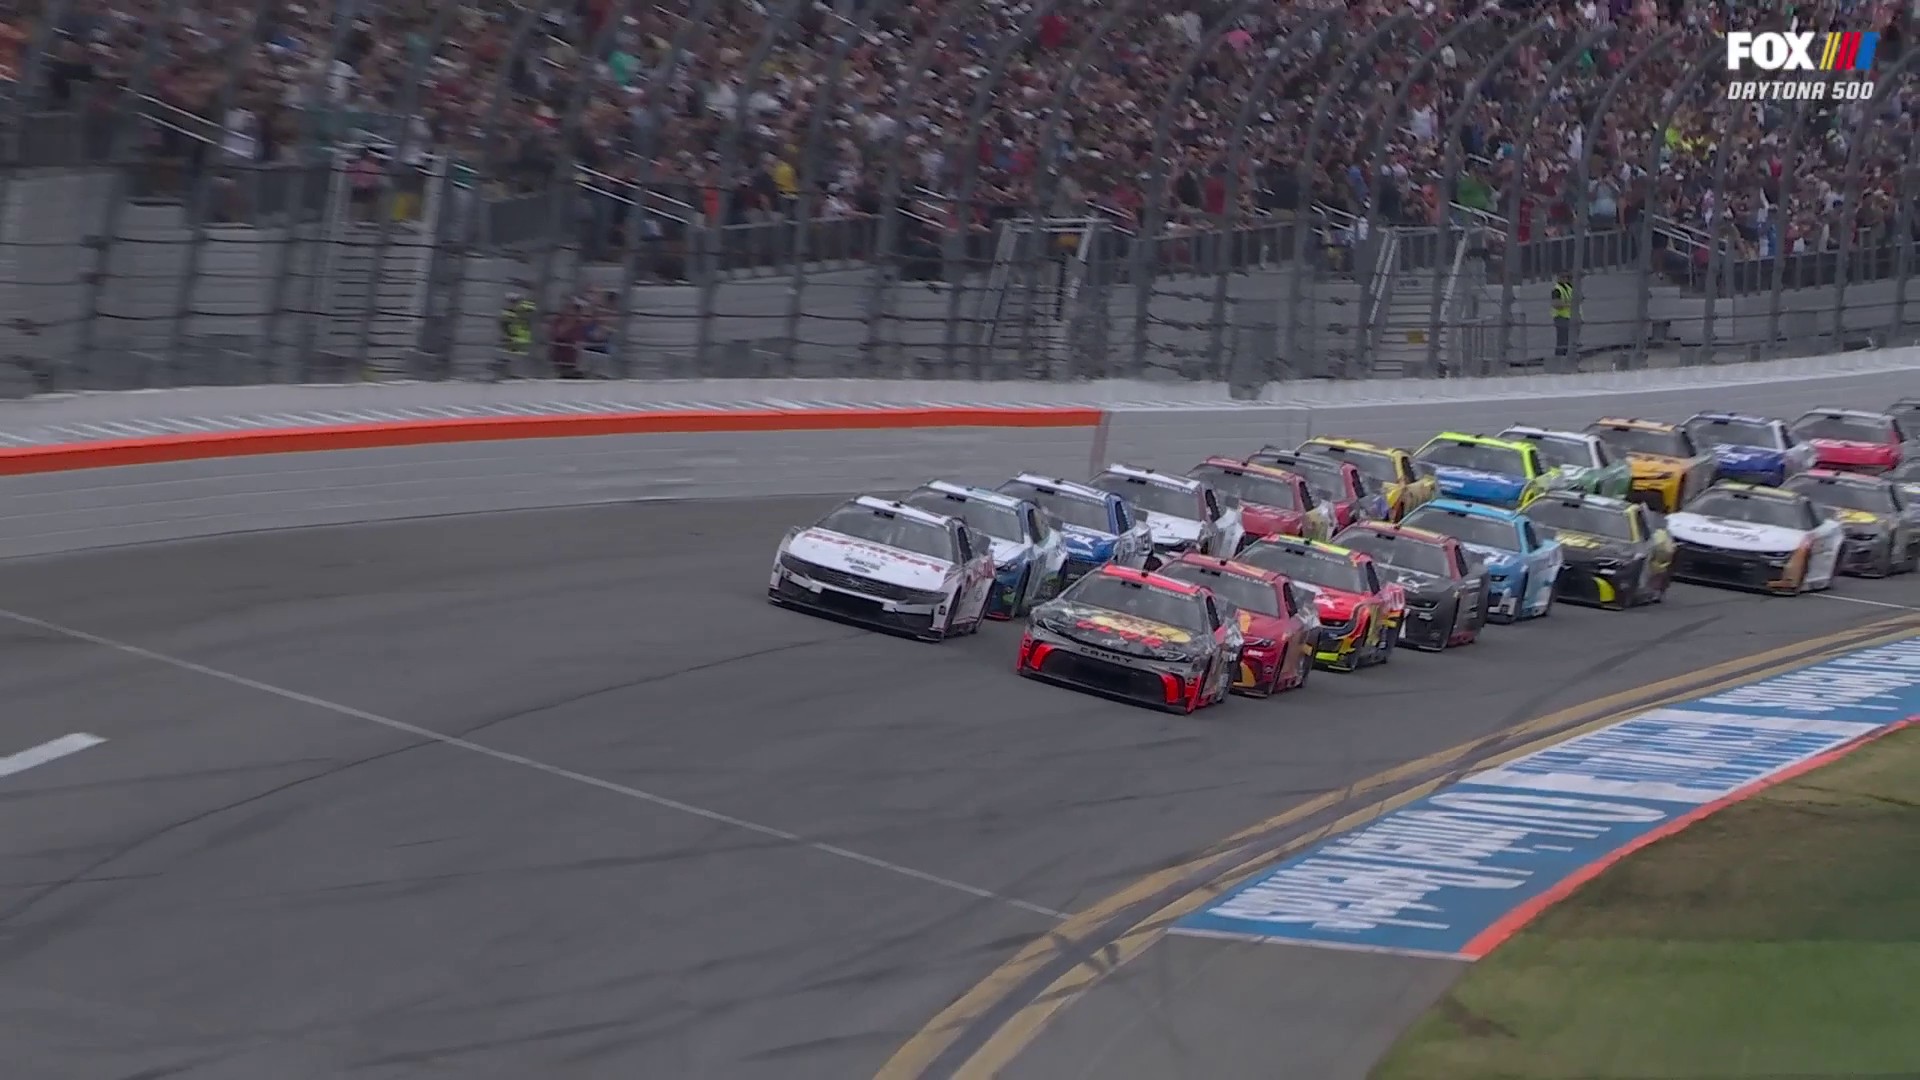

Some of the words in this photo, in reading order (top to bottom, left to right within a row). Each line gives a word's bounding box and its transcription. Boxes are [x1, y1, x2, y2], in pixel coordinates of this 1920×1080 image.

[1080, 646, 1132, 663] CAMRY
[1316, 811, 1612, 876] United
[1206, 858, 1528, 931] Rentals
